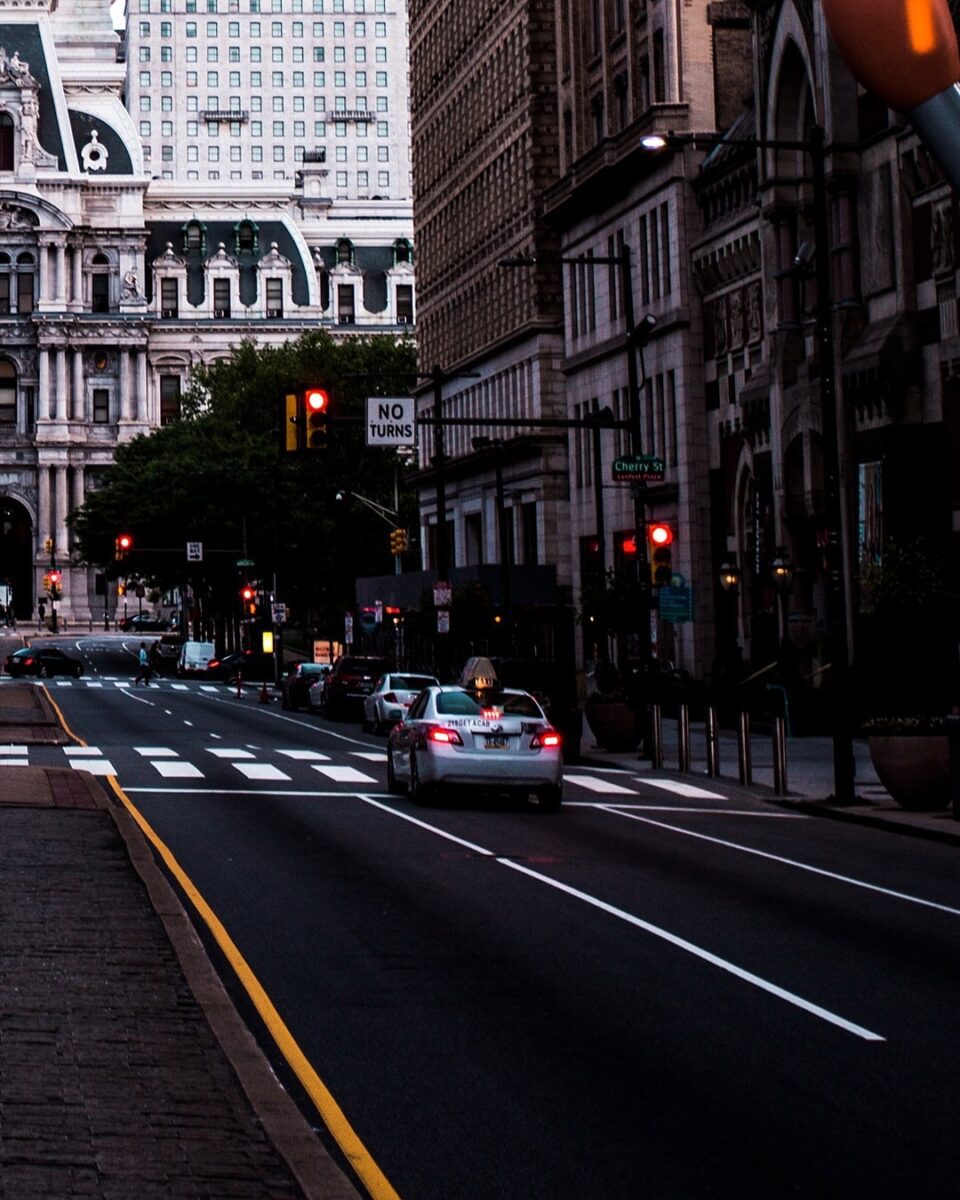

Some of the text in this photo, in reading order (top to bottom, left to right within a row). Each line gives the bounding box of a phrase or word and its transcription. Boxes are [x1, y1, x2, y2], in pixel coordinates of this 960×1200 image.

[378, 404, 403, 420] NO
[369, 424, 412, 438] TURNS
[614, 460, 663, 472] Cherry St
